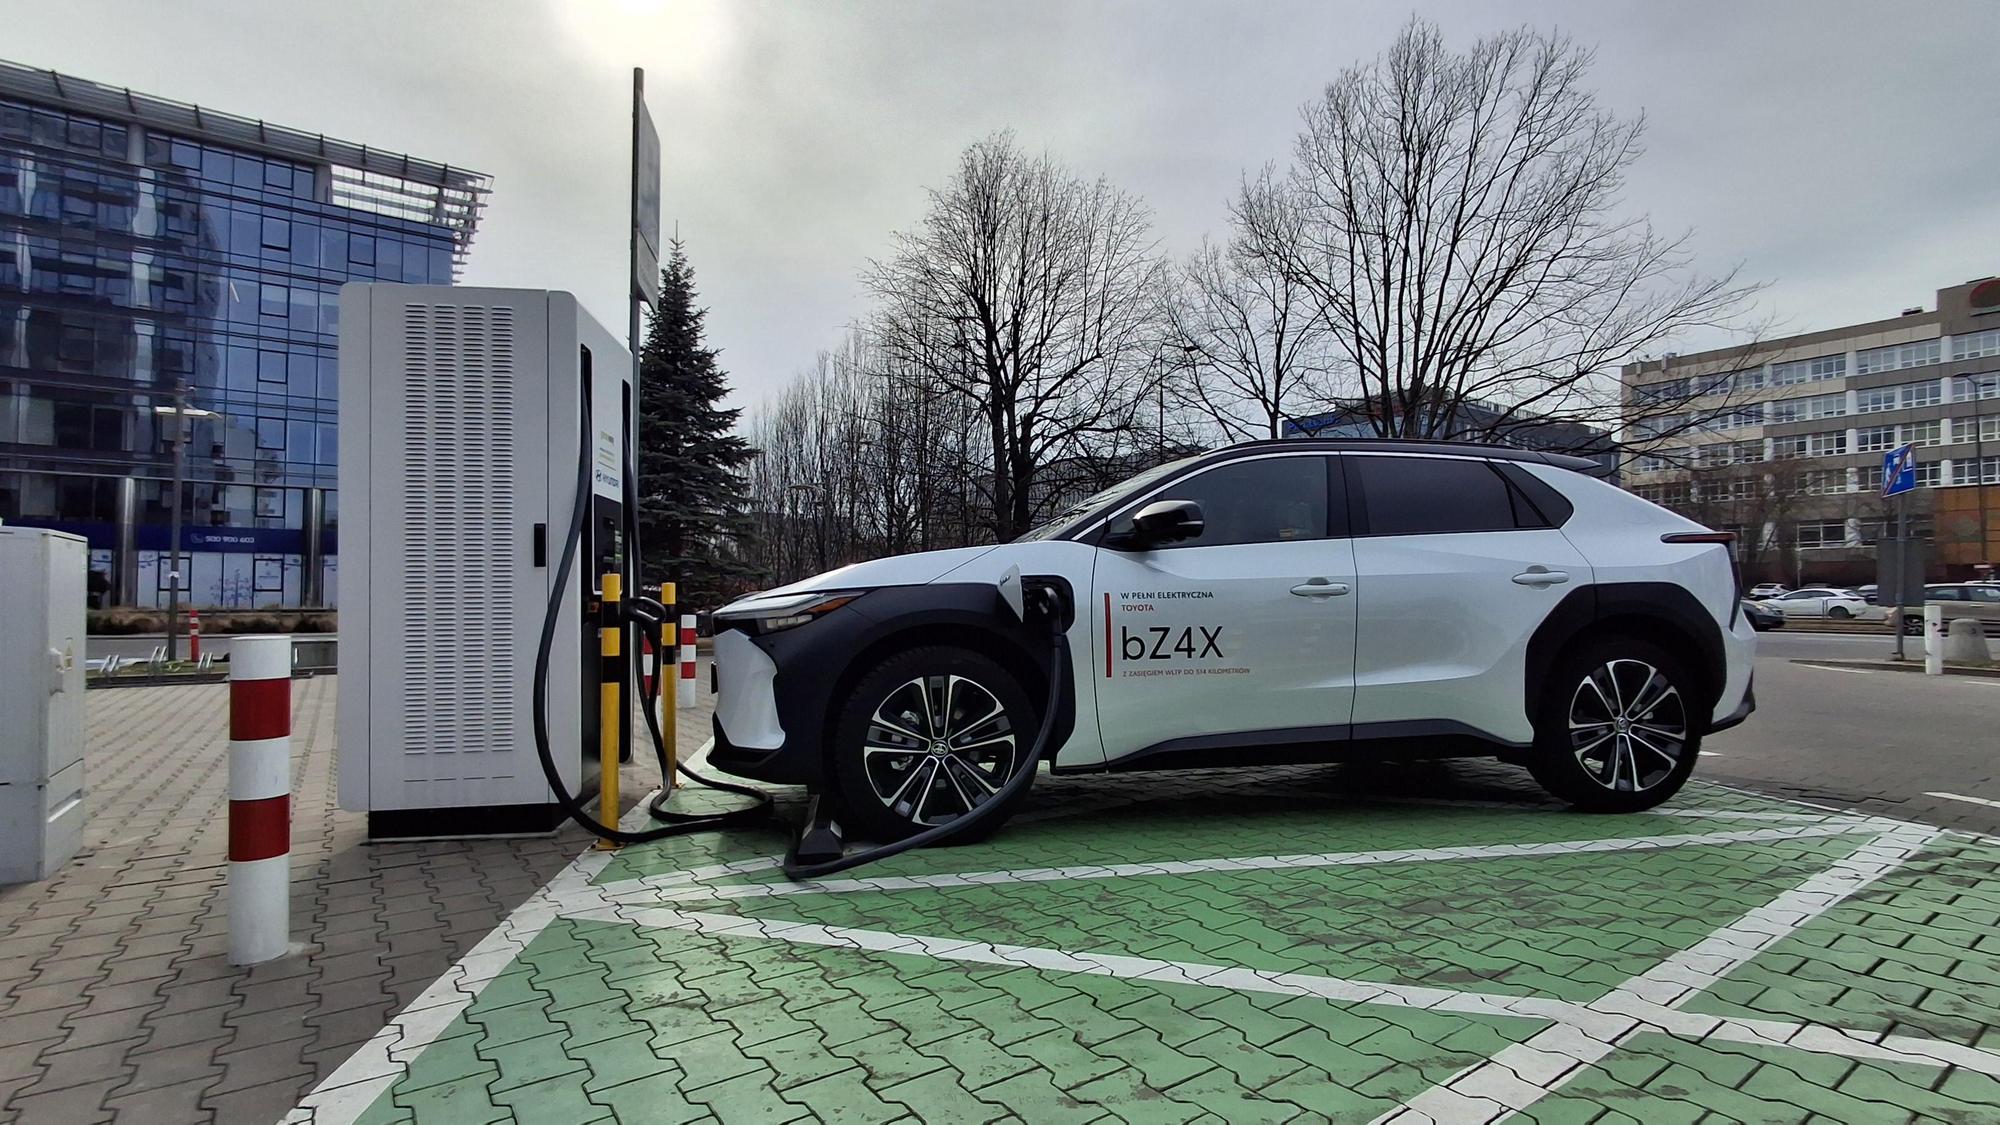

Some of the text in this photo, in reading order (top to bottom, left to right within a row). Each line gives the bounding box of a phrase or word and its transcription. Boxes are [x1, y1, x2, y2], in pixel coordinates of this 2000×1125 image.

[1120, 591, 1214, 600] W PEŁNI ELEKTRYCZNA
[1121, 604, 1154, 612] TOYOTA
[1122, 626, 1223, 660] bZ4X
